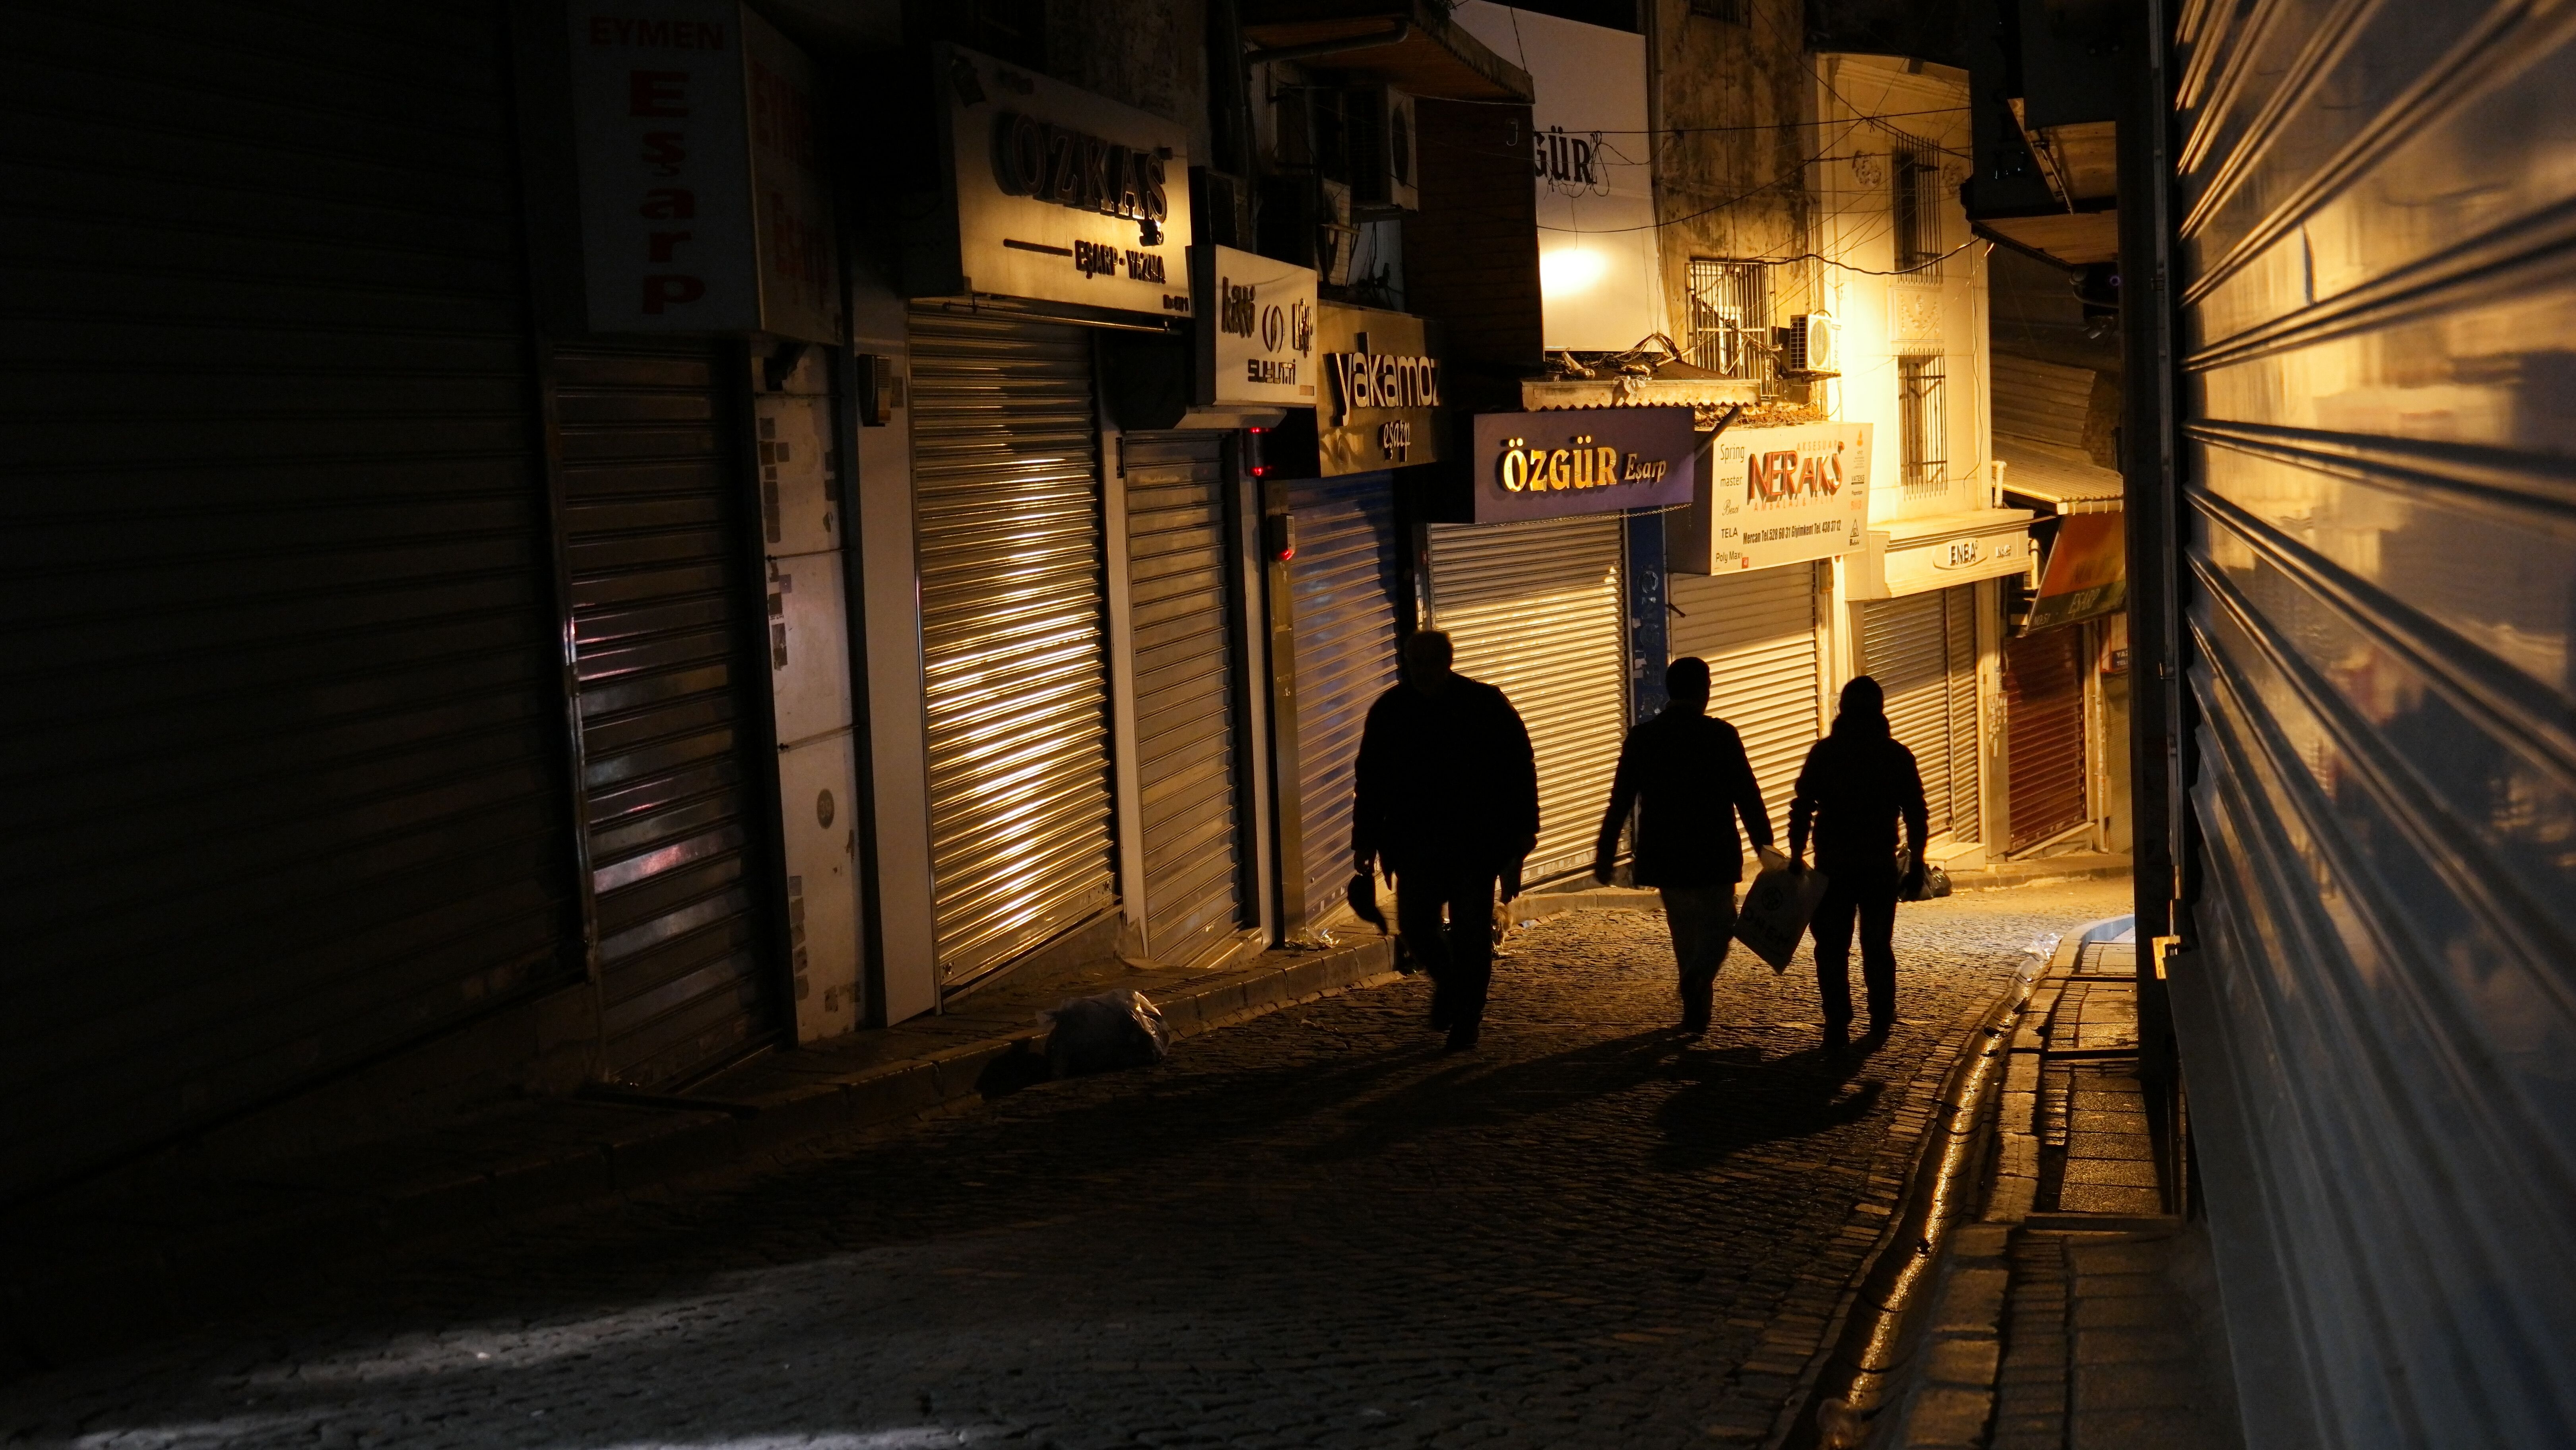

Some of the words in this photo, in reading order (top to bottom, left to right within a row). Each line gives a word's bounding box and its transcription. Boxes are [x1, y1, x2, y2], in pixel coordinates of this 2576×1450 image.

[589, 16, 725, 50] EYMEN
[629, 70, 706, 315] Eşarp
[1075, 240, 1118, 279] EŞARP
[1125, 249, 1166, 284] YAZMA
[1323, 331, 1443, 427] yakamoz
[1379, 419, 1411, 463] eşarp
[1720, 443, 1745, 464] Spring
[1501, 435, 1618, 492] ÖZGÜR
[1624, 452, 1667, 484] Eşarp
[1748, 442, 1845, 504] NERAKS
[1720, 475, 1743, 487] master
[1754, 498, 1798, 512] AMBALAJ
[1721, 527, 1738, 539] TELA
[1743, 532, 1761, 545] Mercan
[1779, 527, 1785, 540] 60
[1786, 527, 1790, 539] 31
[1822, 521, 1831, 533] 438
[1831, 520, 1836, 532] 37
[1837, 520, 1841, 531] 12
[1716, 552, 1728, 564] Poly
